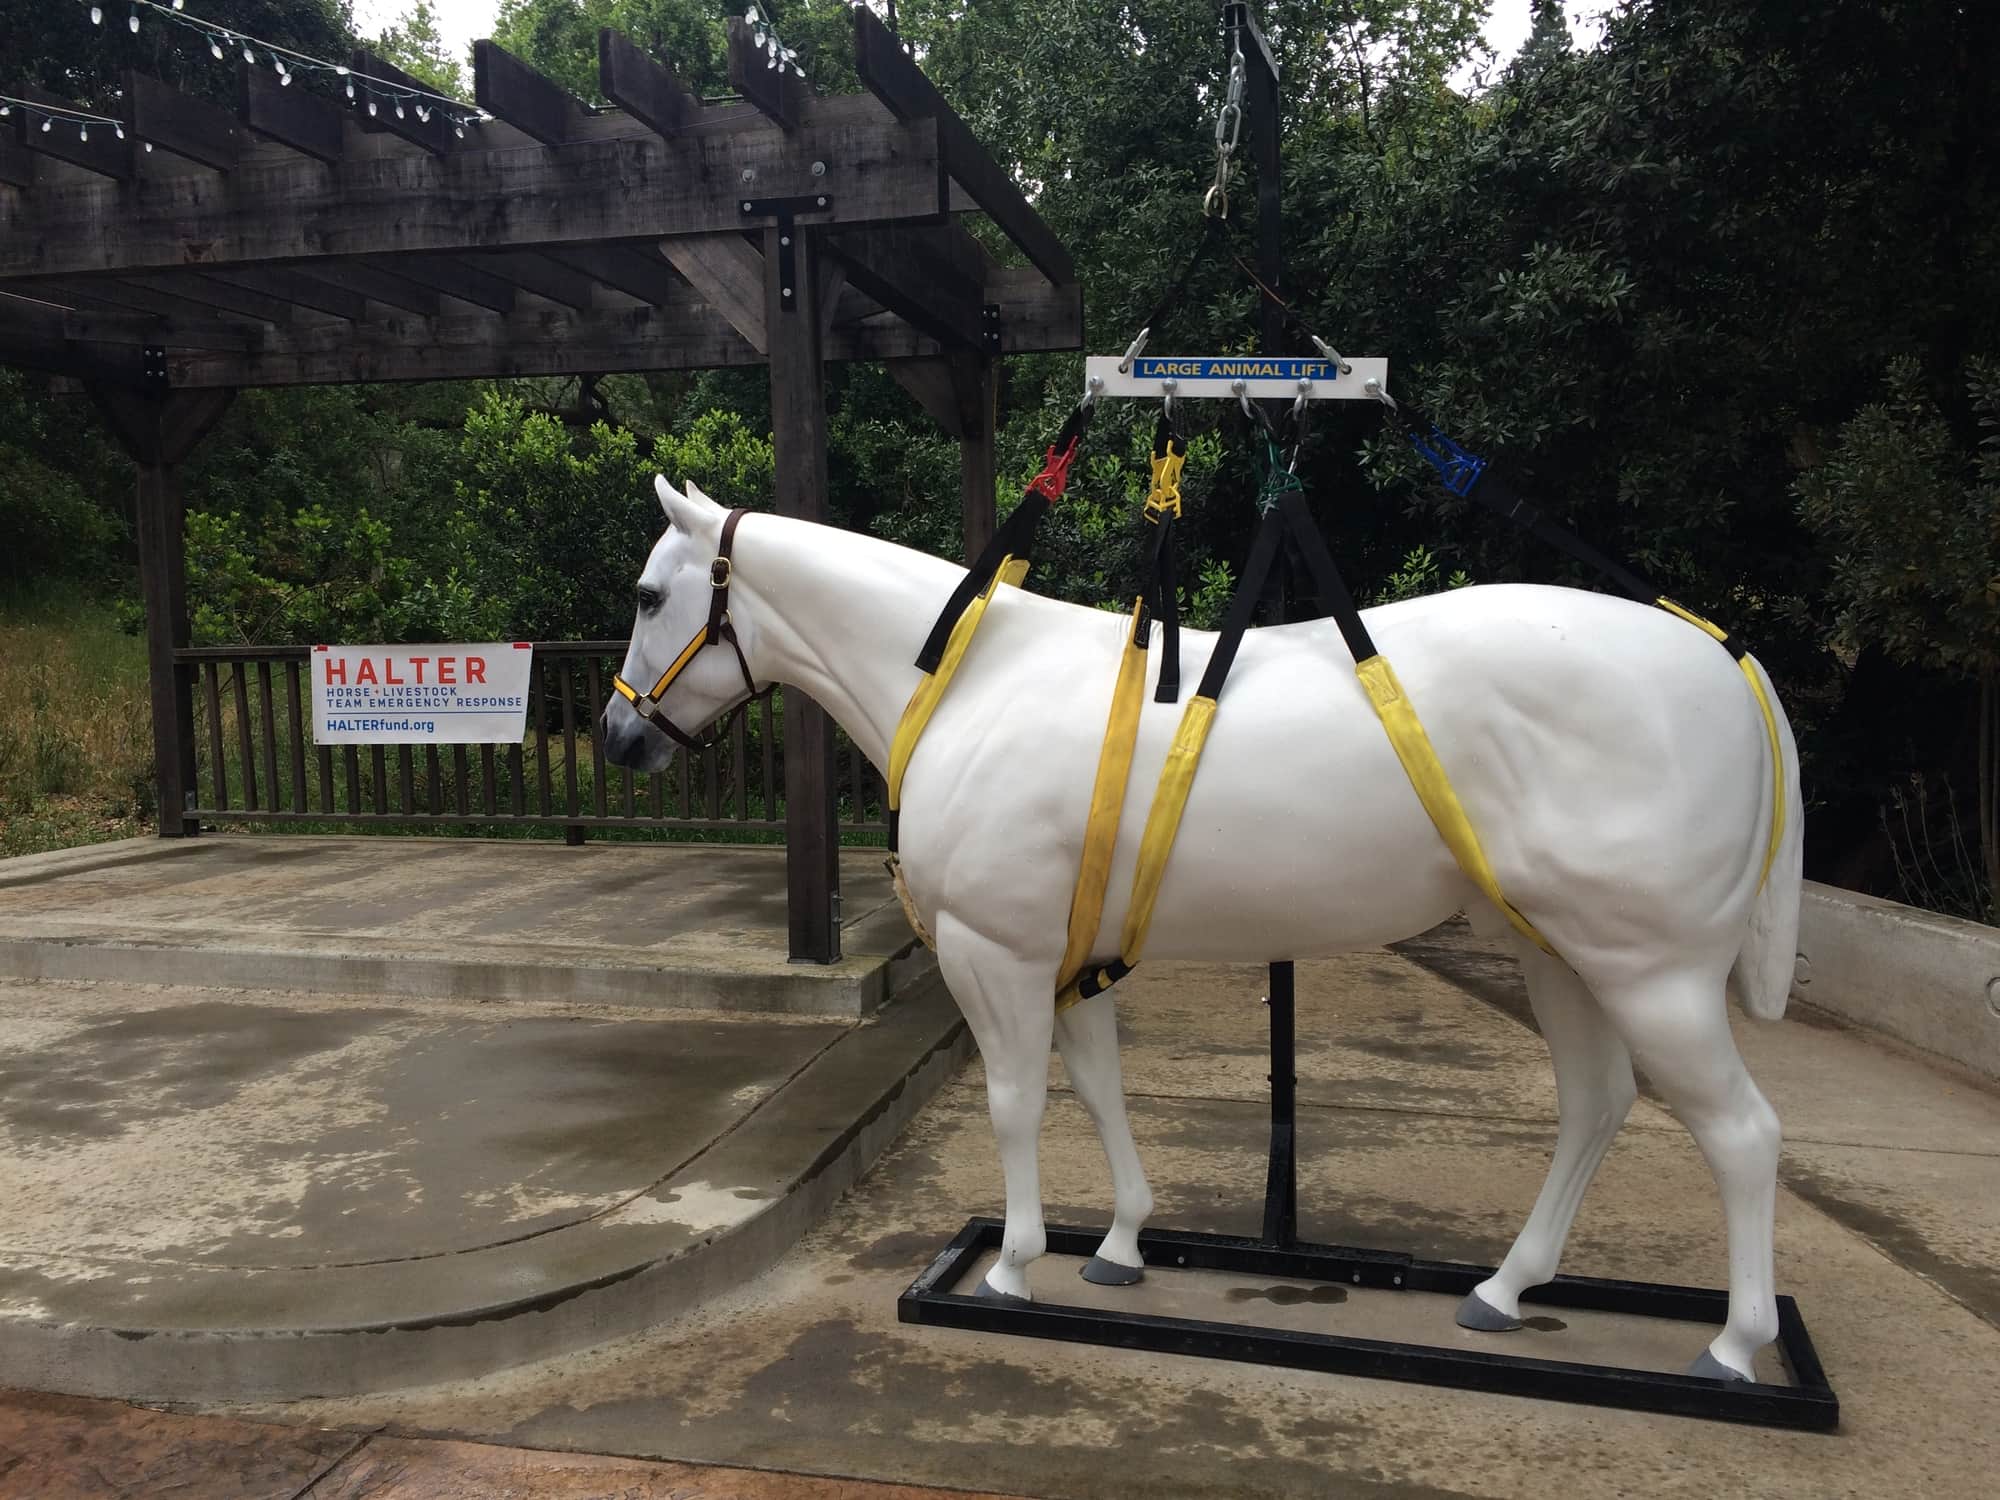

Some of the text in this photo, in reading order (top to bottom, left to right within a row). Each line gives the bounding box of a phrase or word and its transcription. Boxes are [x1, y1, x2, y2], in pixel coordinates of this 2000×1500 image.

[1143, 363, 1328, 377] LARGE ANIMAL LIFT
[325, 657, 487, 685] HALTER
[327, 687, 457, 697] HORSE LIVESTOCK
[328, 697, 522, 708] TEAM EMERGENCY RESPONSE
[327, 719, 434, 733] HALTERfund.org
